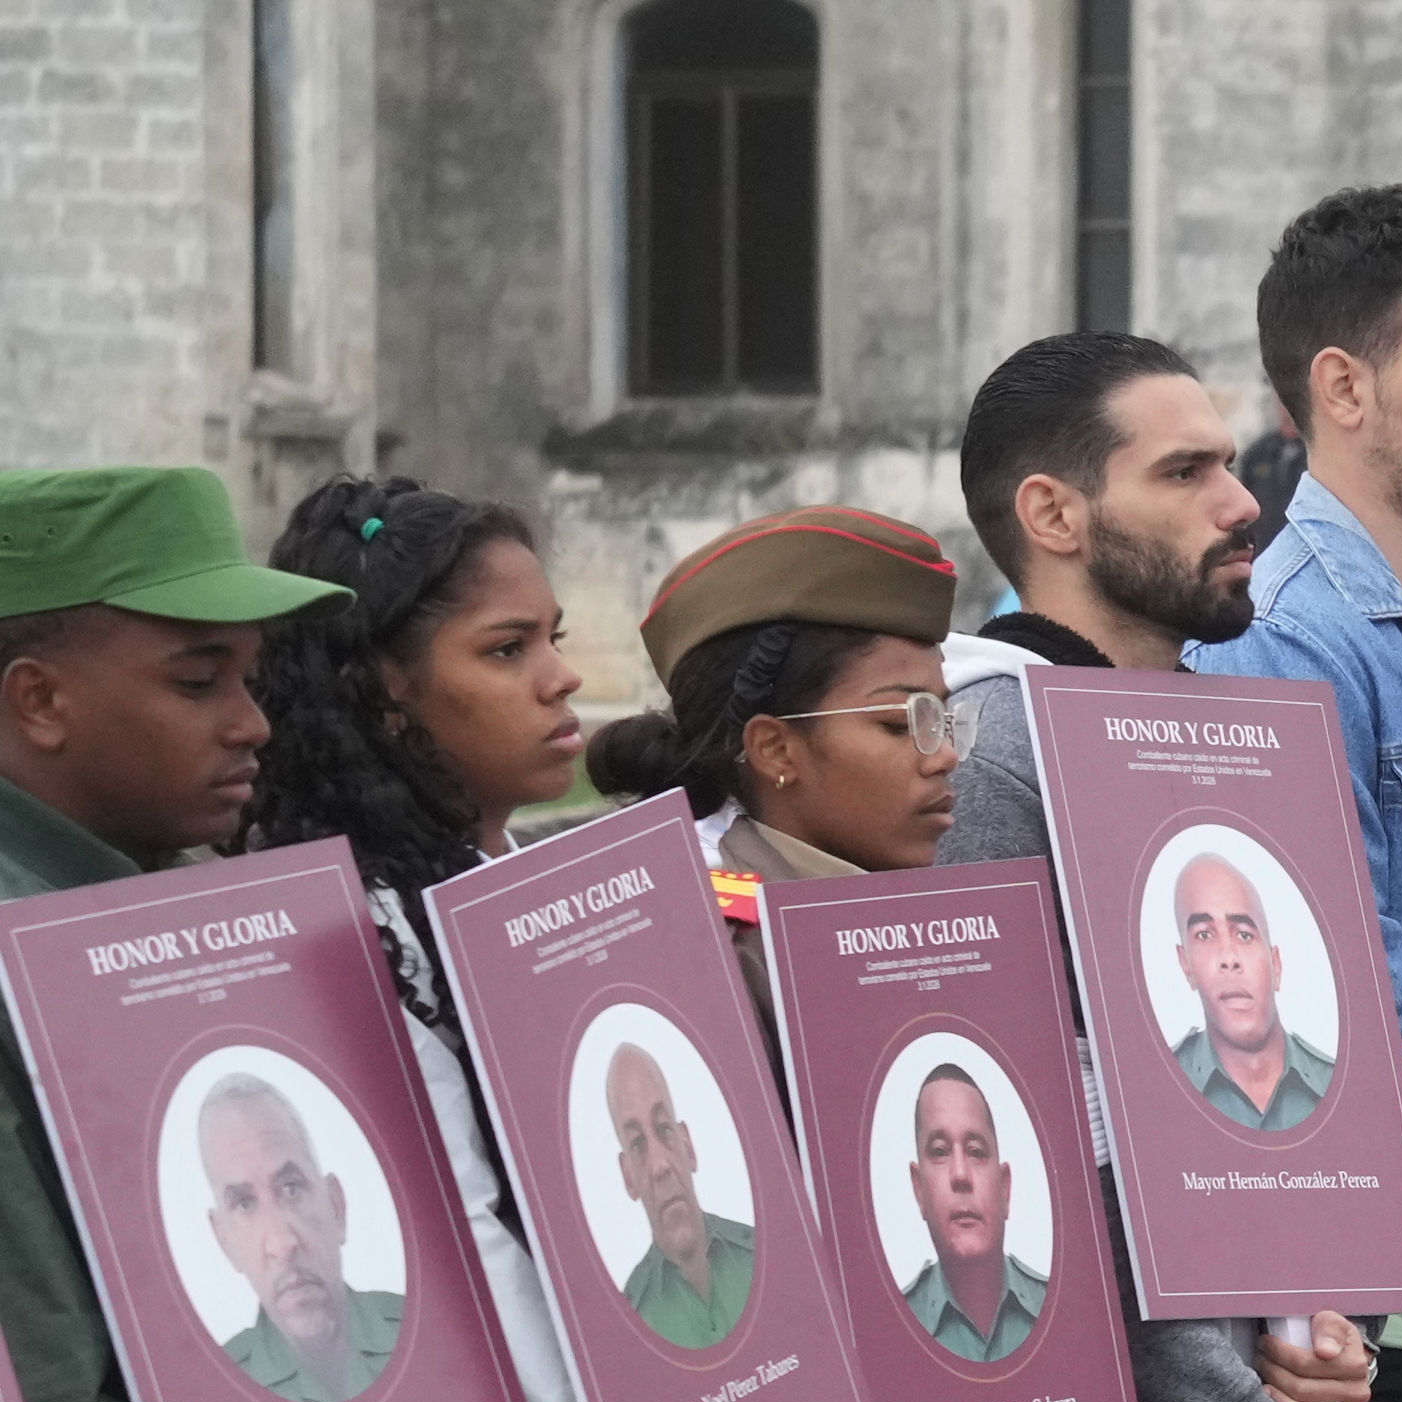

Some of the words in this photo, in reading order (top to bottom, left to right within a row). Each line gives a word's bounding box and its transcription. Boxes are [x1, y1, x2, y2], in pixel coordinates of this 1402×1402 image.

[1104, 718, 1184, 743] HONOR
[1184, 722, 1199, 744] Y
[1203, 723, 1281, 748] GLORIA
[504, 896, 575, 947] HONOR
[570, 892, 587, 919] Y
[586, 866, 655, 913] GLORIA
[86, 931, 183, 976] HONOR
[180, 926, 200, 956] Y
[202, 909, 298, 950] GLORIA
[836, 924, 911, 955] HONOR
[910, 922, 925, 947] Y
[928, 915, 1000, 946] GLORIA
[1182, 1172, 1226, 1195] Mayor
[1228, 1172, 1277, 1189] Hernán
[1278, 1171, 1338, 1189] González
[1338, 1171, 1379, 1189] Perera
[726, 1376, 760, 1402] Pérez
